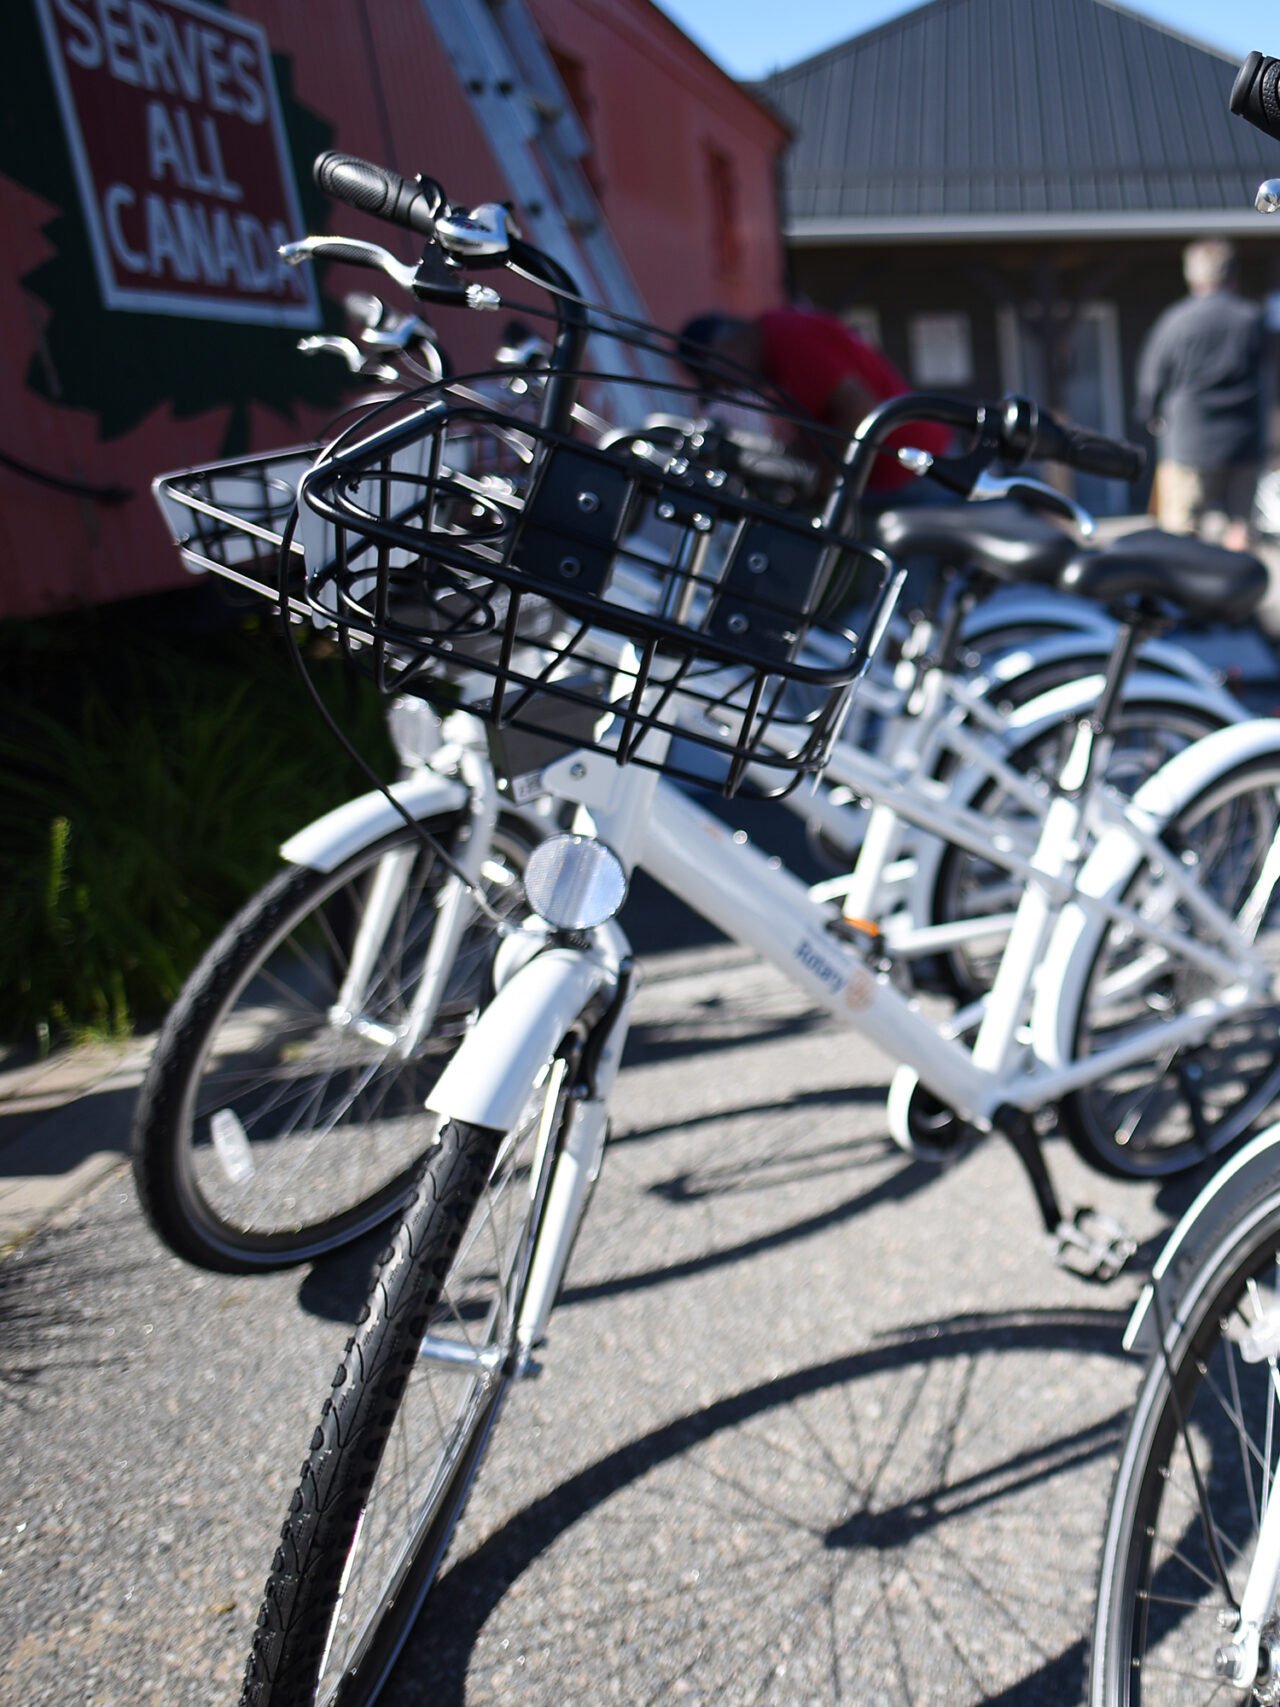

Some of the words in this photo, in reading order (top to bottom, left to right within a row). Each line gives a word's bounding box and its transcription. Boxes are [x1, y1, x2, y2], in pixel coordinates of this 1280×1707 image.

[54, 0, 267, 125] SERVES
[147, 101, 243, 200] ALL
[104, 184, 308, 298] CANADA
